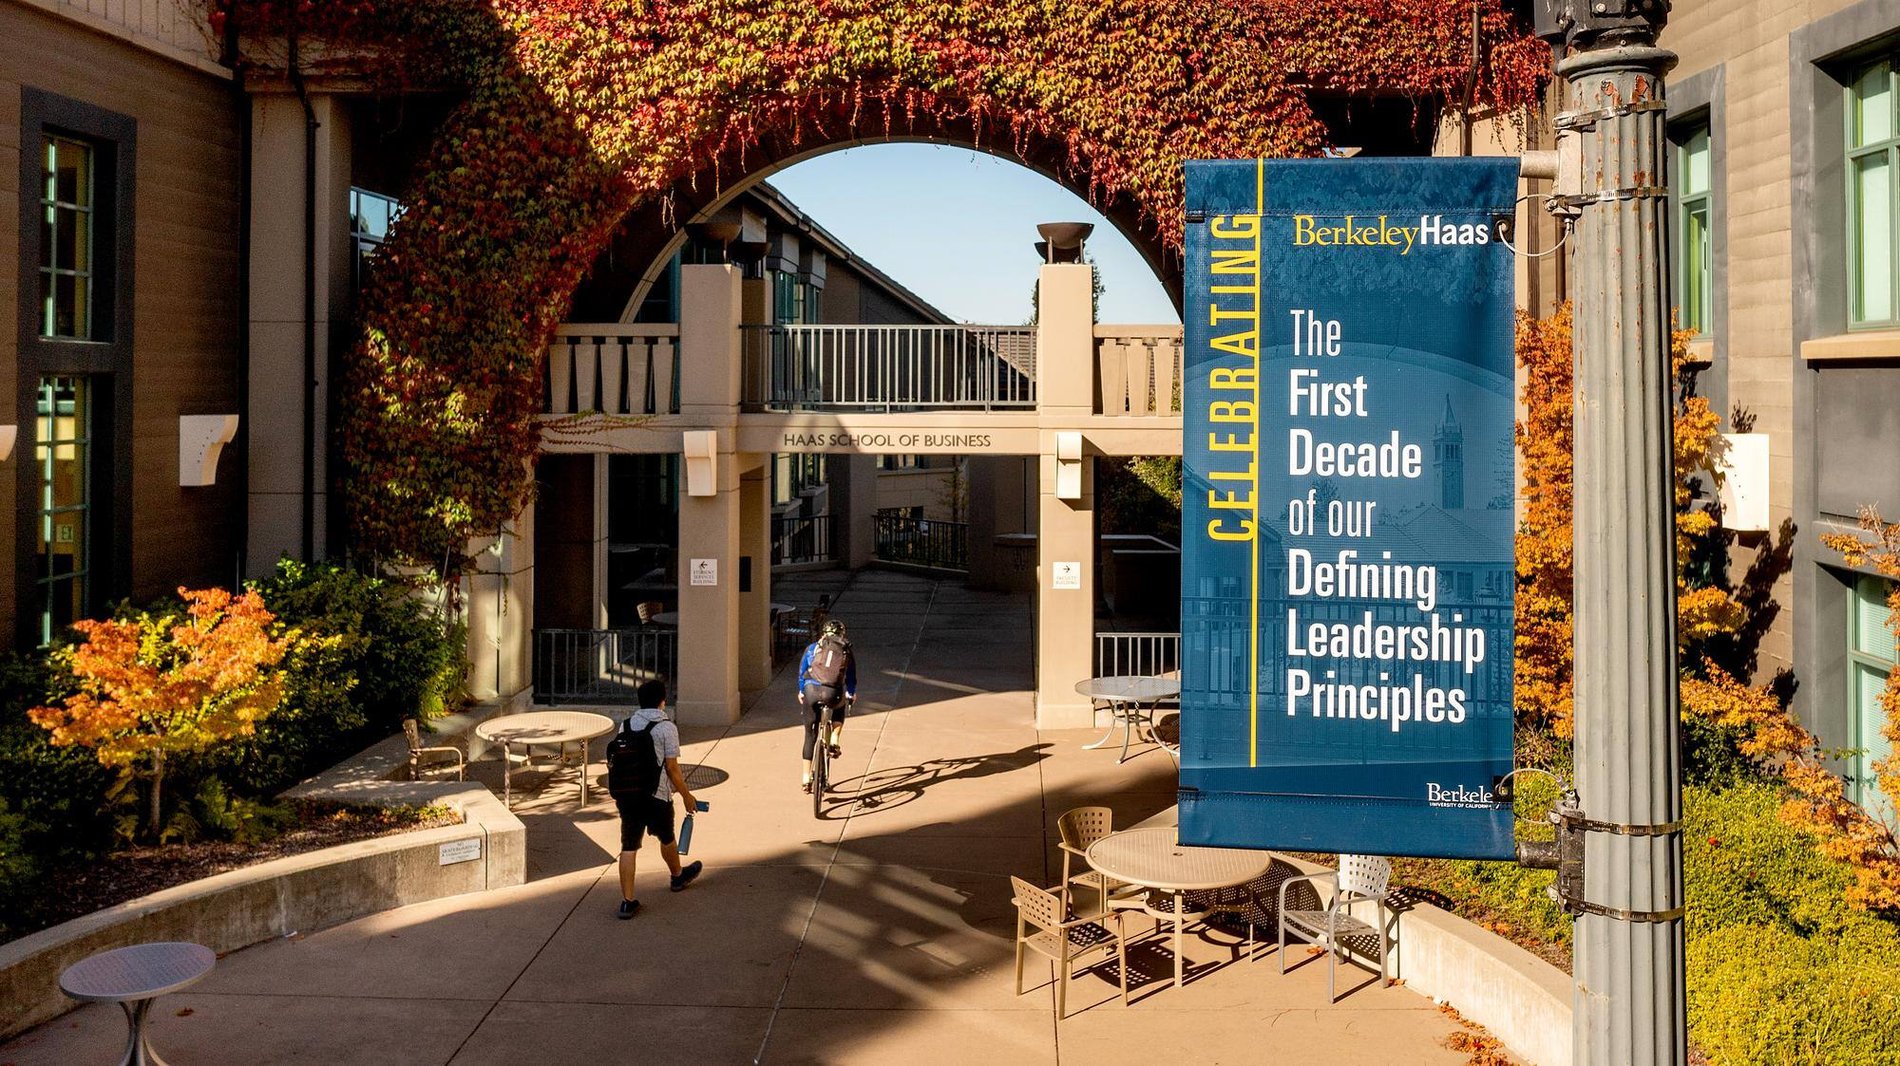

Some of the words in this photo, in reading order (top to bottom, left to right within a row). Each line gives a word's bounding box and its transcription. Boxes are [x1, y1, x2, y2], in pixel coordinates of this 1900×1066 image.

[1290, 309, 1341, 356] The
[1208, 215, 1258, 541] CELEBRATING
[1289, 369, 1368, 417] First
[784, 434, 825, 447] HAAS
[829, 434, 895, 447] SCHOOL
[899, 434, 920, 447] OF
[924, 434, 991, 447] BUSINESS
[1289, 429, 1422, 478] Decade
[1289, 489, 1317, 536] of
[1328, 500, 1377, 538] our
[1288, 549, 1436, 612] Defining
[1288, 608, 1485, 674] Leadership
[1287, 668, 1467, 732] Principles
[1426, 782, 1500, 809] Berkele
